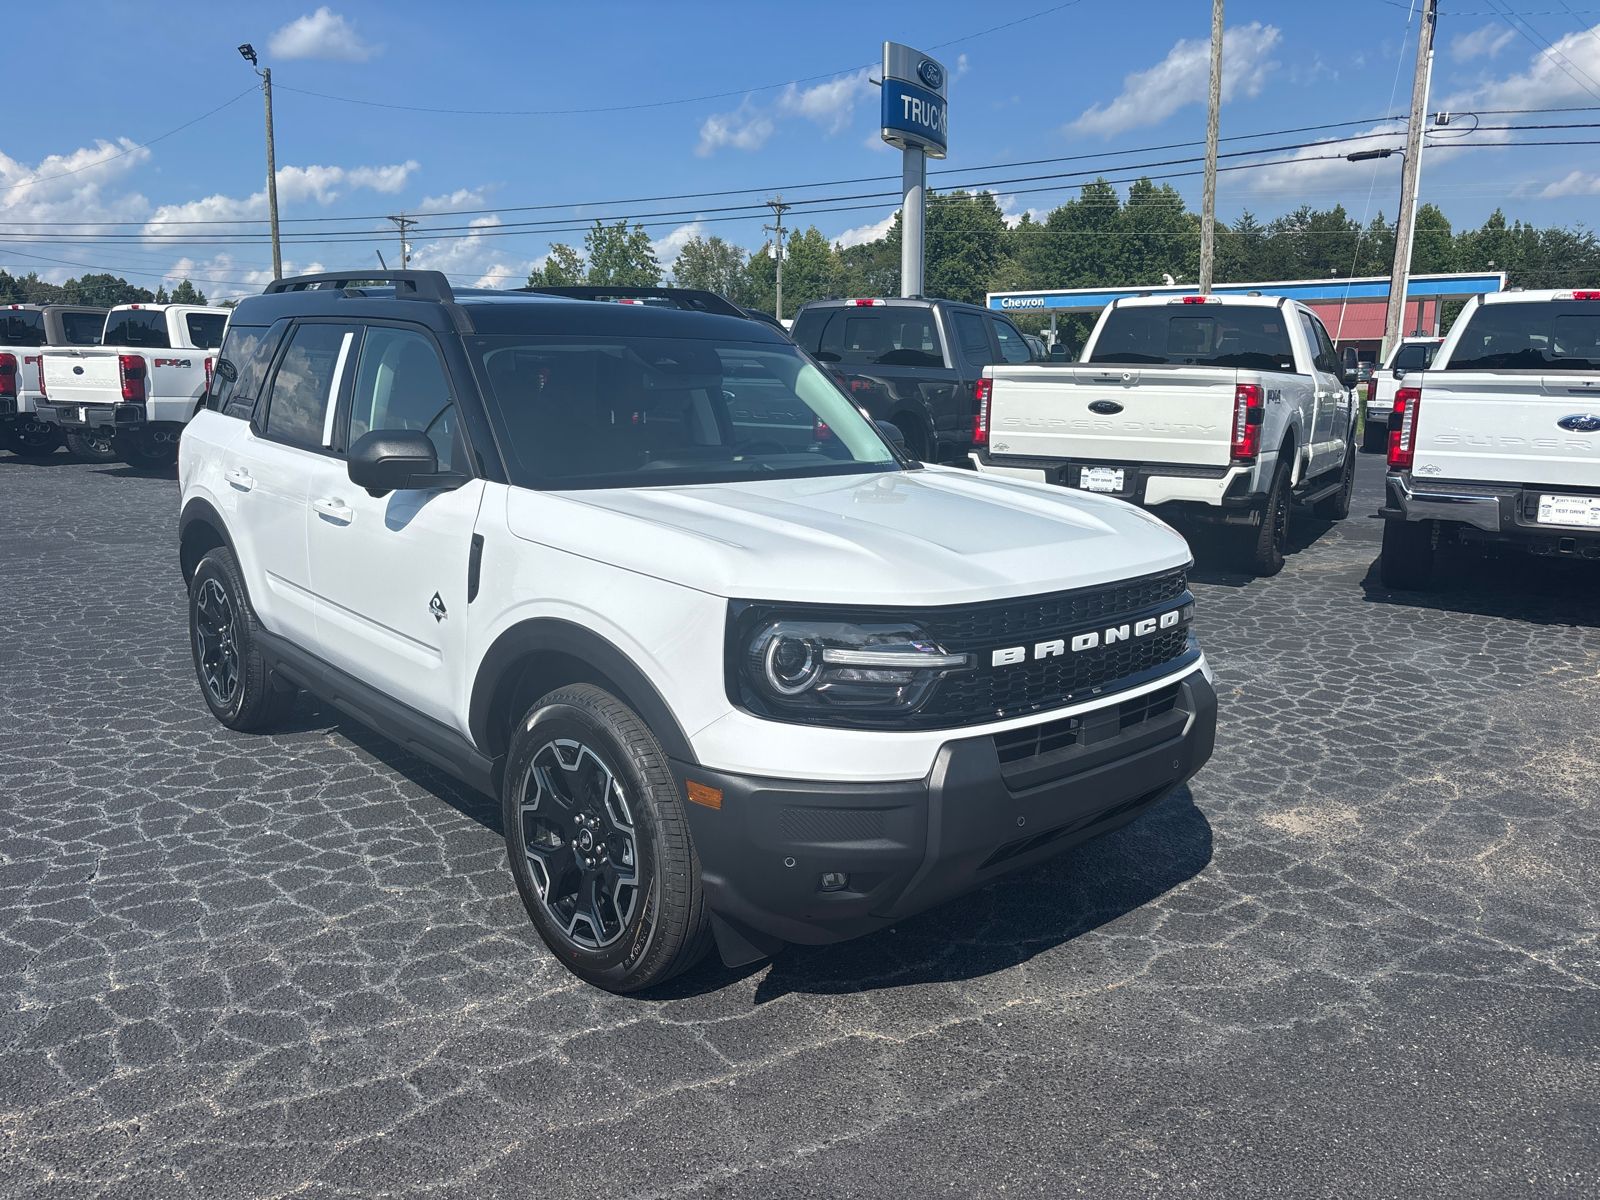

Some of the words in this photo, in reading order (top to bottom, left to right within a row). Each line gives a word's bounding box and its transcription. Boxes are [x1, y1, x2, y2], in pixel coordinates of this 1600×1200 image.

[926, 64, 940, 84] Ford
[1001, 297, 1045, 308] Chevron
[154, 358, 192, 368] FX4
[1002, 417, 1114, 431] SUPER
[1123, 421, 1217, 435] DUTY
[1568, 417, 1596, 430] Ford
[1434, 434, 1592, 451] SUPER
[991, 609, 1180, 668] BRONCO
